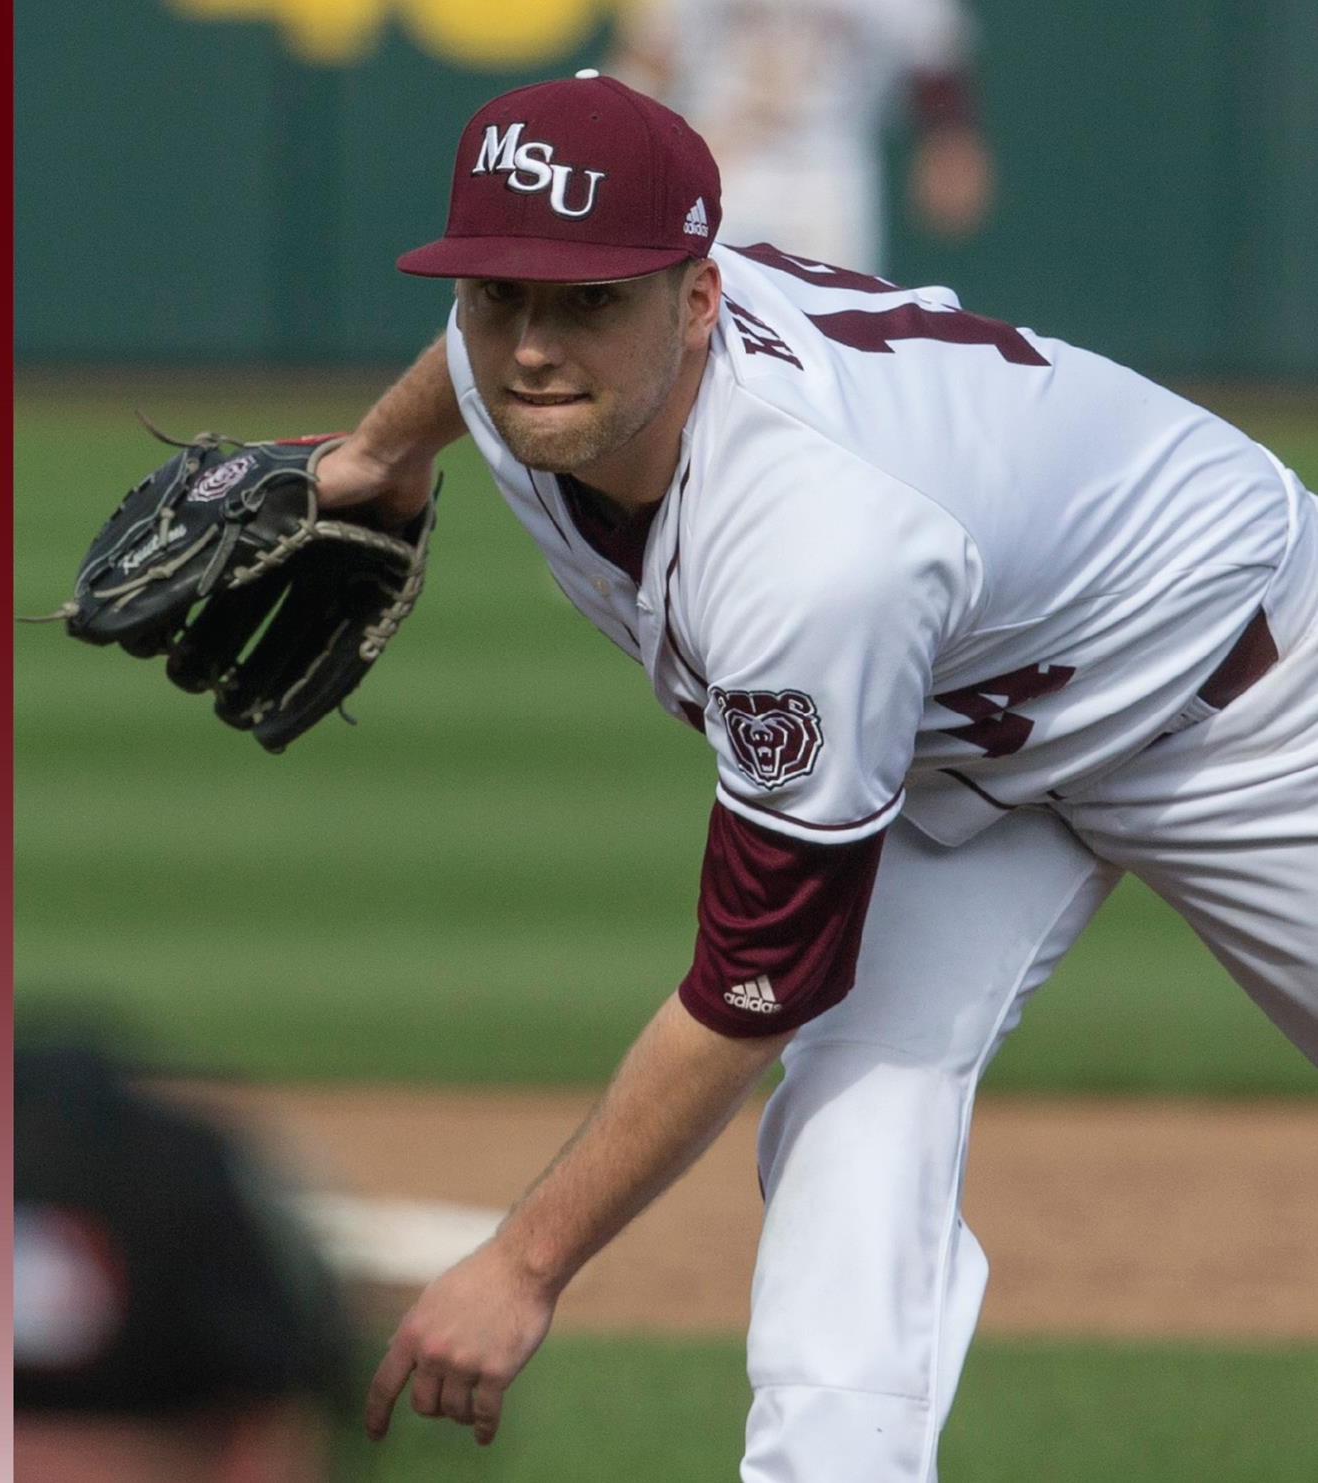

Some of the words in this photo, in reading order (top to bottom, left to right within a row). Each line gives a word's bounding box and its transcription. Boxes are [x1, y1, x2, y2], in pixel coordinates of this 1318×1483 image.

[470, 122, 606, 221] MSU
[682, 221, 709, 238] adidas
[723, 992, 782, 1014] adidas
